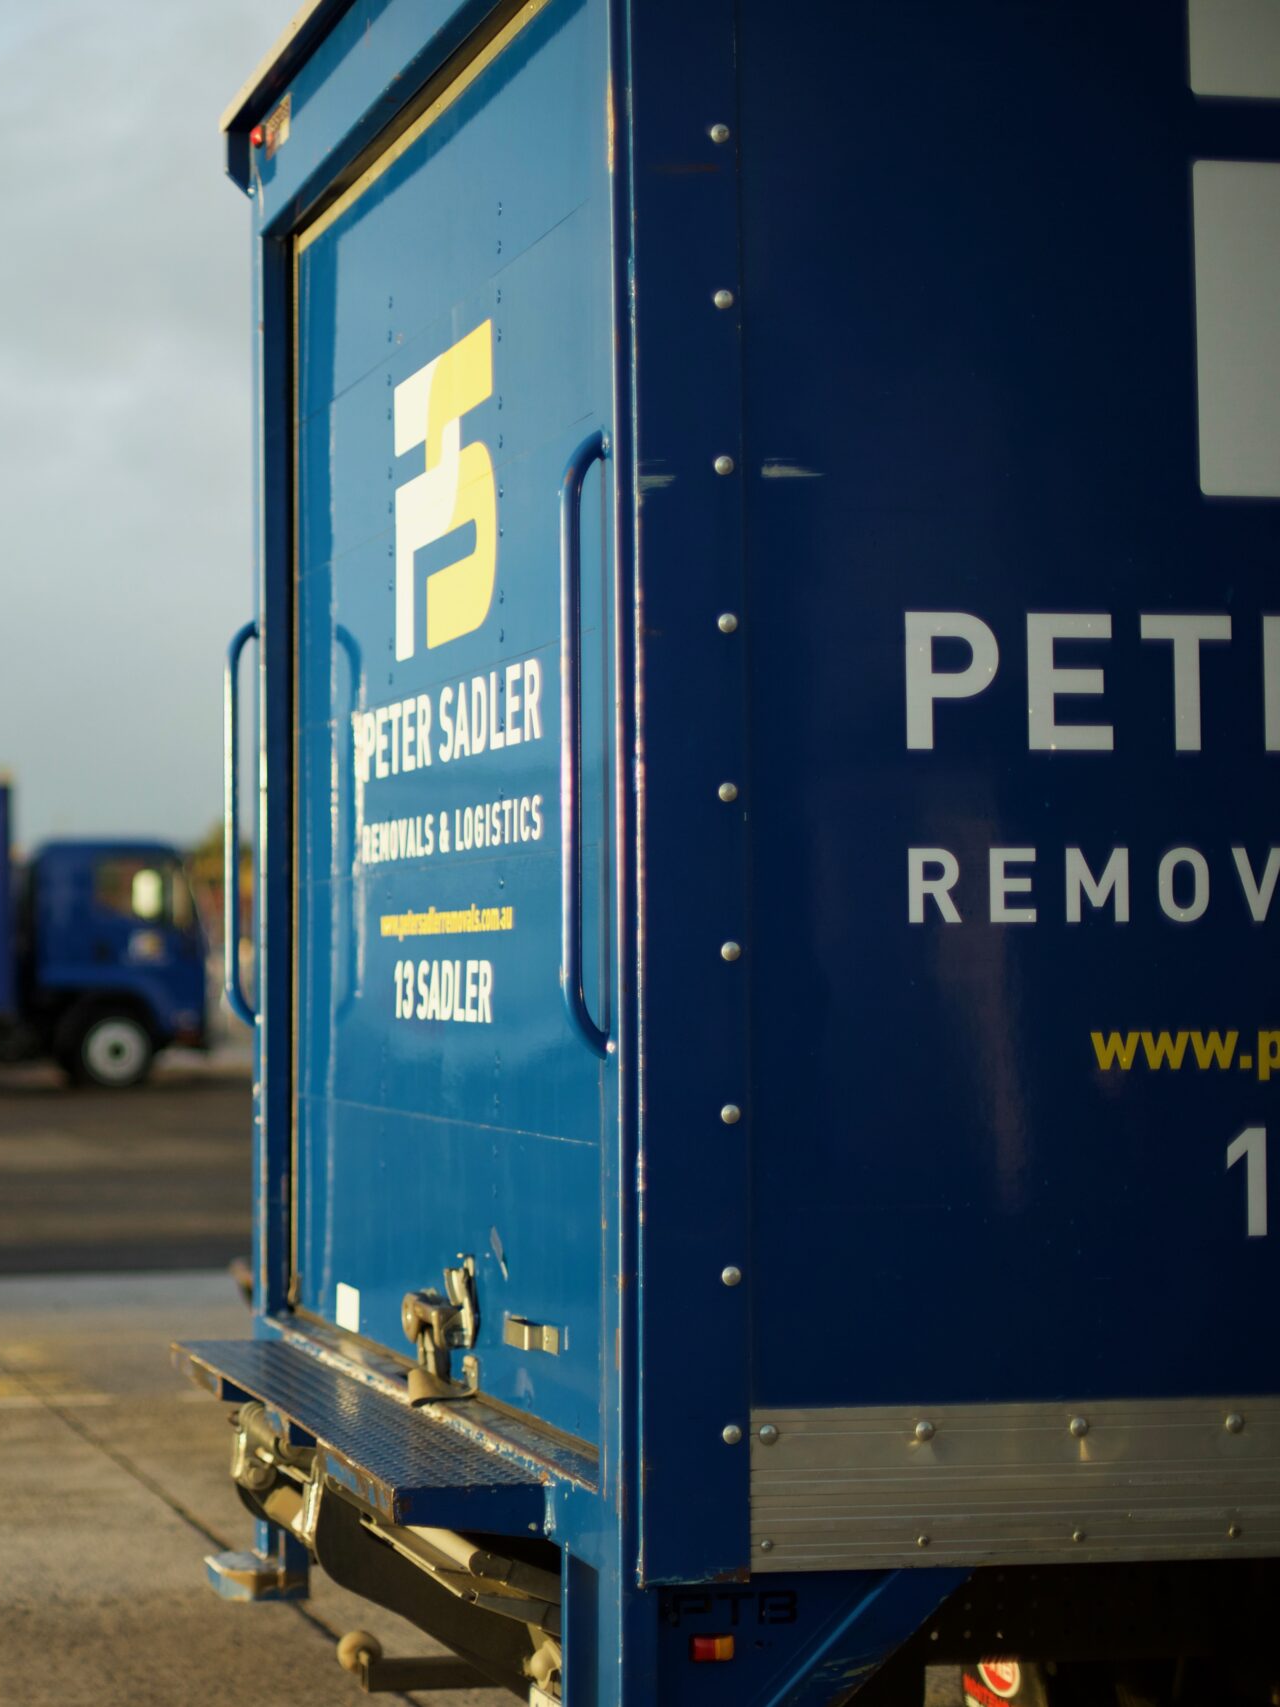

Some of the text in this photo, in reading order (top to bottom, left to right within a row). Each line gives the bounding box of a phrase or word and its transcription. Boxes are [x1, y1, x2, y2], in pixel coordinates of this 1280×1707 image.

[904, 611, 1280, 751] PET
[361, 658, 542, 783] PETER SADLER
[361, 795, 543, 865] REMOVALS & LOGISTICS
[907, 847, 1280, 924] REMOV
[394, 960, 493, 1023] 13 SADLER
